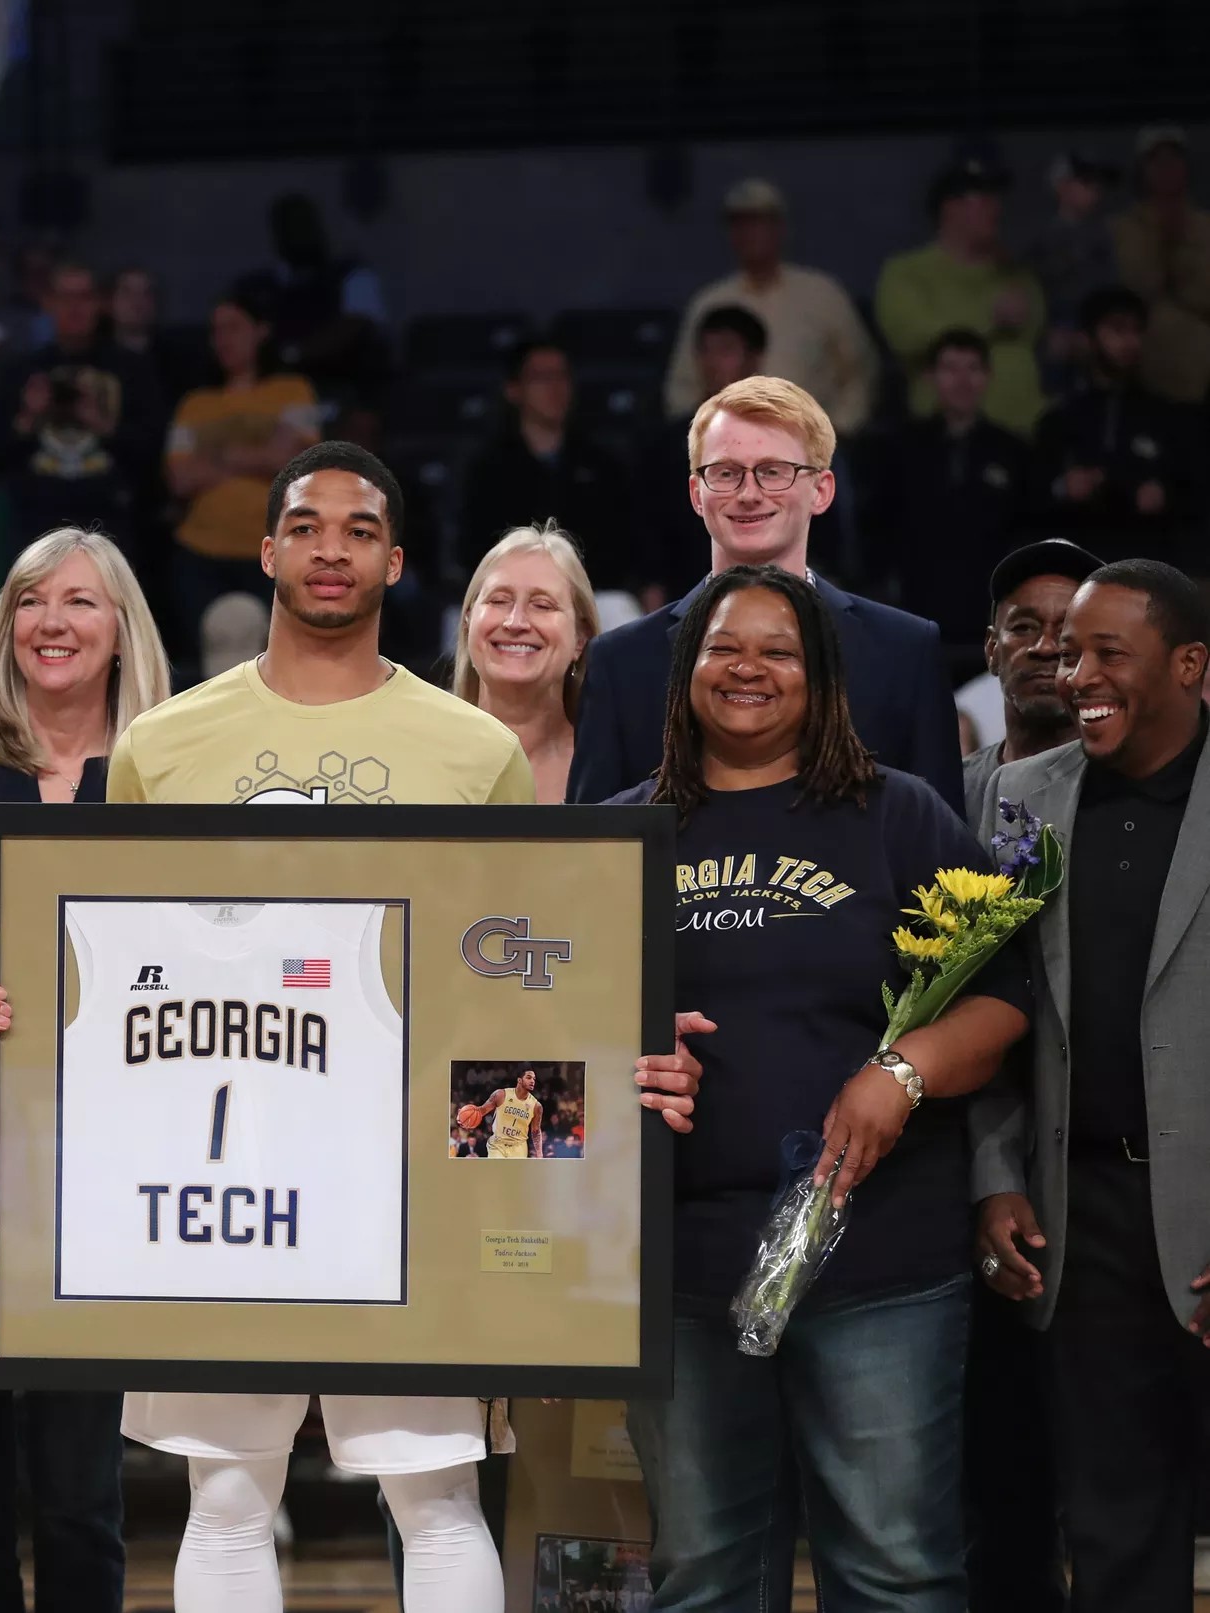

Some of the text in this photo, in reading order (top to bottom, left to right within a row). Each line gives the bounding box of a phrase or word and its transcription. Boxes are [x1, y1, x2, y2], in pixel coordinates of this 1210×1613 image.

[676, 853, 856, 909] RGIA TECH
[676, 889, 802, 908] LOW JACKETS
[676, 907, 765, 931] MOM
[460, 916, 571, 988] GT
[124, 998, 328, 1077] GEORGIA
[206, 1080, 232, 1164] 1
[137, 1183, 300, 1249] TECH
[485, 1236, 505, 1244] Georgia
[521, 1236, 549, 1244] Basketball
